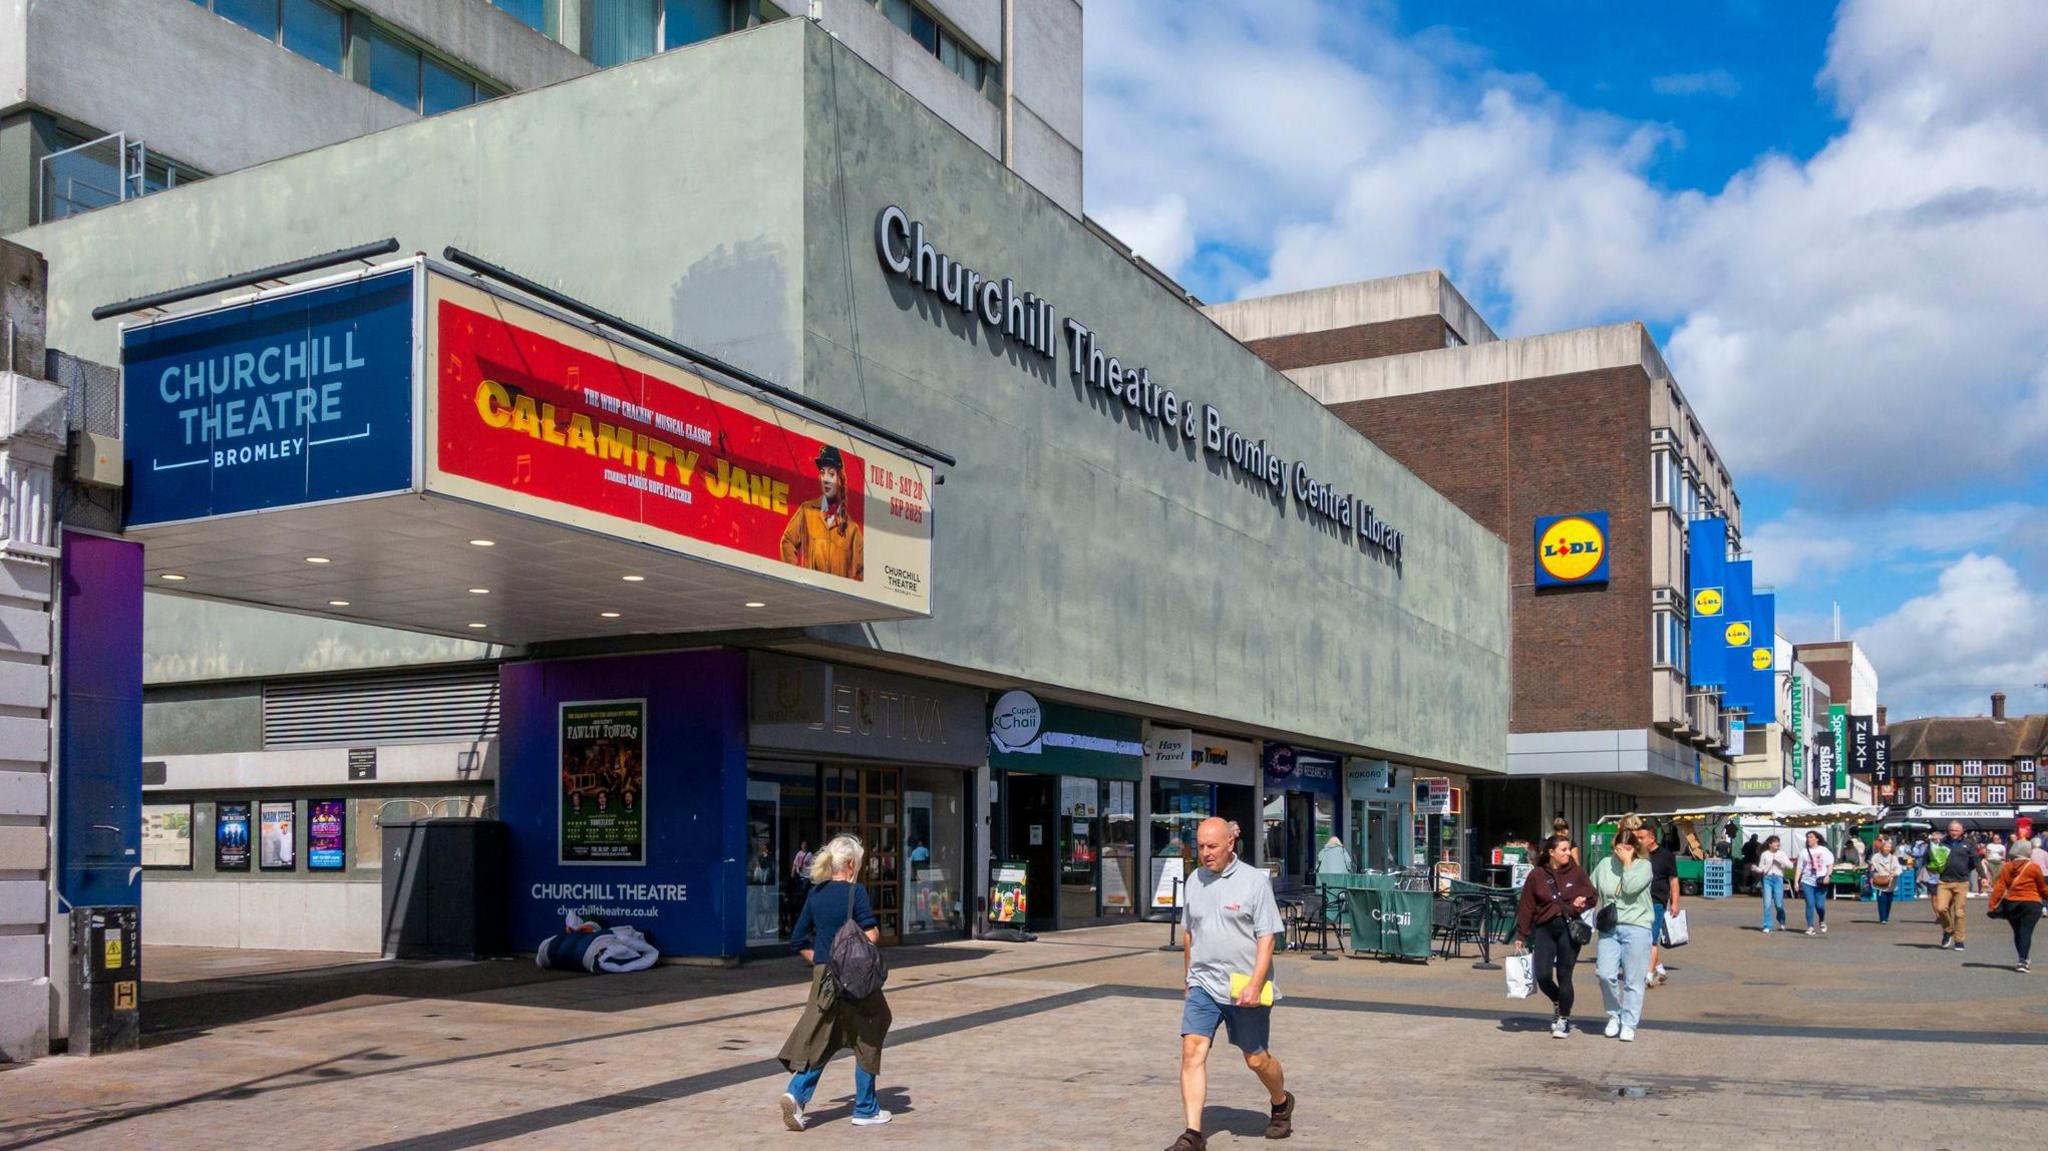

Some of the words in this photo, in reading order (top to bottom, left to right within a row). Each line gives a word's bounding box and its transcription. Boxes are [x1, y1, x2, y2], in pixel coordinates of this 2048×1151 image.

[160, 331, 365, 403] CHURCHILL
[876, 205, 1056, 359] Churchill
[1064, 318, 1179, 427] Theatre
[1182, 400, 1198, 440] &
[1203, 404, 1289, 497] Bromley
[1292, 461, 1354, 527] Central
[1357, 500, 1404, 563] Library
[179, 382, 342, 445] THEATRE
[584, 387, 600, 408] THE
[600, 392, 621, 415] WHIP
[655, 412, 685, 437] MUSICAL
[685, 423, 712, 447] CLASSIC
[214, 438, 304, 468] BROMLEY
[474, 379, 699, 487] CALAMITY
[705, 458, 790, 516] JANE
[648, 478, 664, 496] HOPE
[664, 483, 692, 504] FLETCHER
[871, 464, 885, 487] TUE
[885, 470, 893, 490] 16
[899, 475, 912, 497] SAT
[890, 496, 903, 517] SEP
[905, 500, 922, 523] 2025
[884, 564, 921, 583] CHURCHILL
[888, 576, 917, 592] THEATRE
[567, 726, 601, 739] FAWLTY
[603, 724, 638, 739] TOWERS
[1856, 721, 1867, 768] NEXT
[1155, 751, 1185, 761] Travel
[1159, 741, 1182, 751] Hays
[1820, 746, 1834, 797] slaters
[1875, 740, 1886, 781] NEXT
[531, 883, 614, 900] CHURCHILL
[617, 884, 687, 901] THEATRE
[557, 905, 659, 917] churchilltheatre.co.uk
[118, 984, 134, 1006] H
